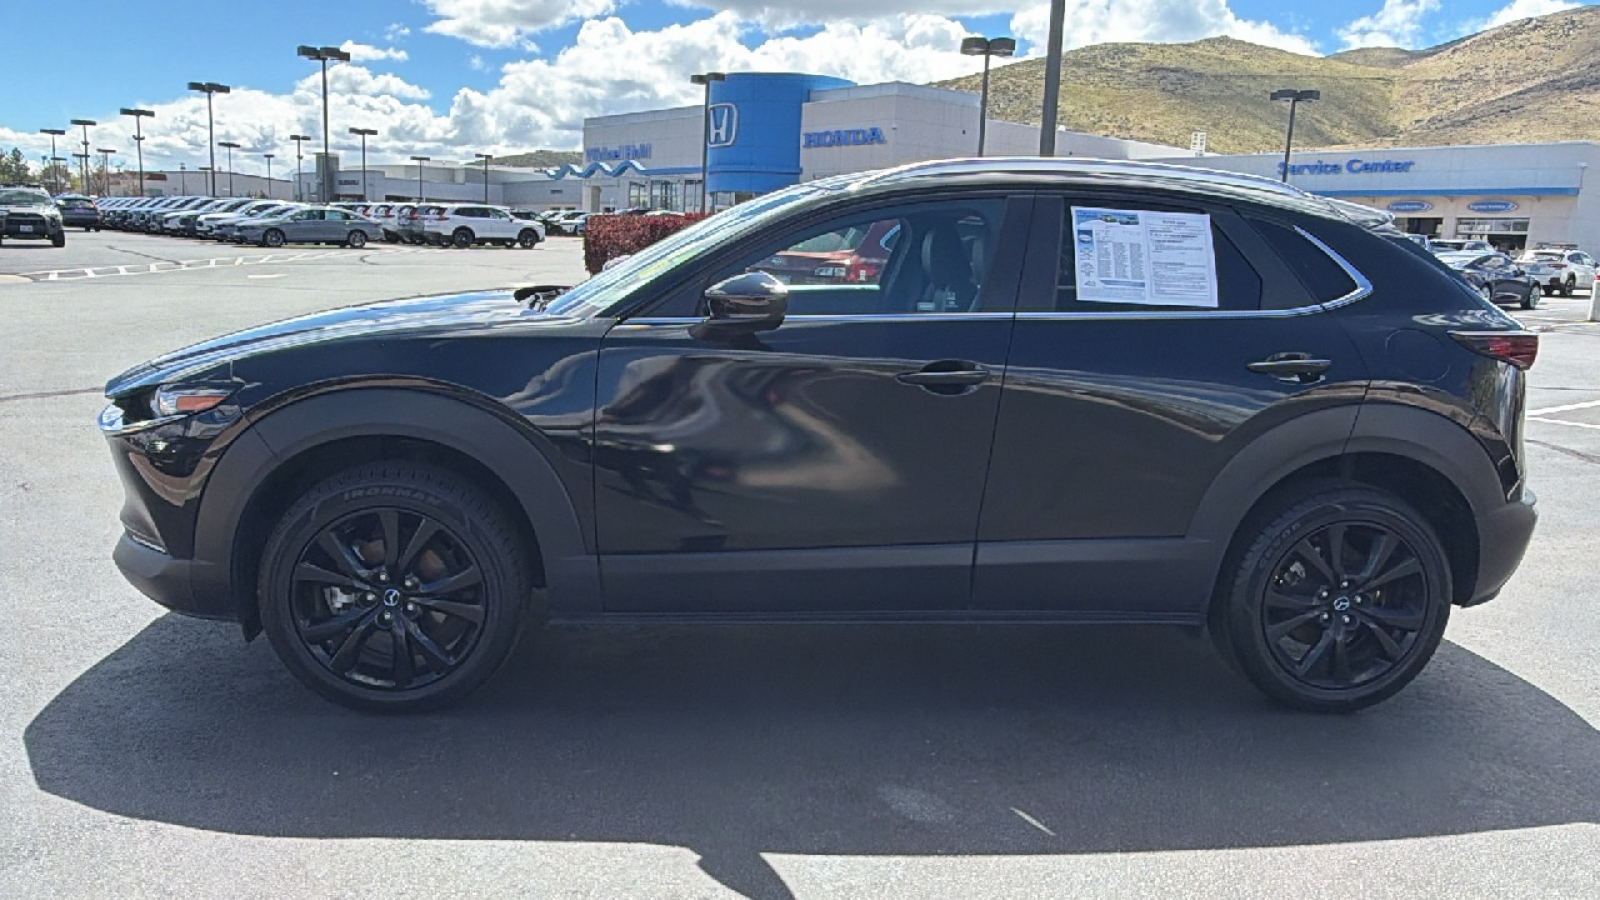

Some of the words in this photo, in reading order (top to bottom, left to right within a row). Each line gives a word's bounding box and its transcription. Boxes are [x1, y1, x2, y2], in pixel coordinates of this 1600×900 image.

[803, 127, 885, 148] HONDA
[1277, 160, 1342, 175] Service
[1345, 159, 1415, 173] Center
